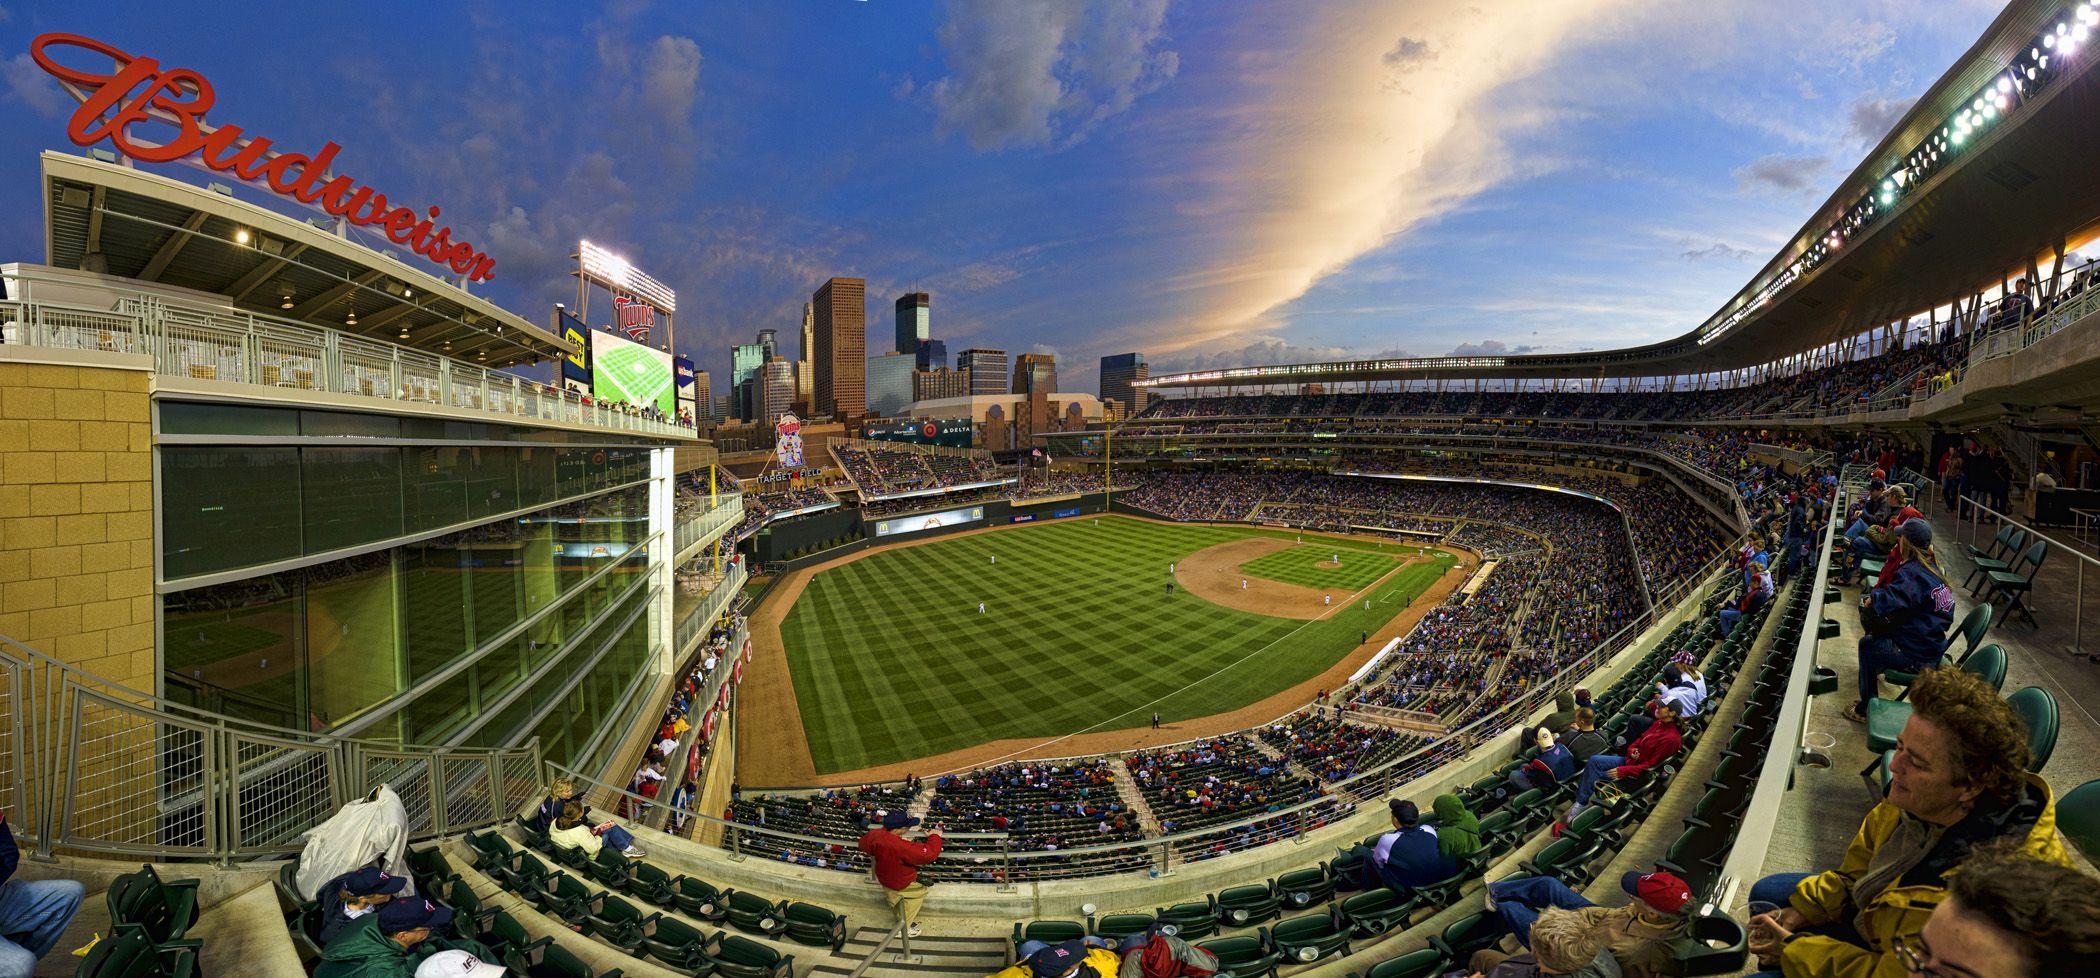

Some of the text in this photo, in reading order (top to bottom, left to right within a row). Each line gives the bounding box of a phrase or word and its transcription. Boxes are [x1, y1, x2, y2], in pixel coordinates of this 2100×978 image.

[30, 31, 495, 283] Budweiser
[614, 296, 654, 331] Twins
[757, 468, 822, 483] TARGET FIELD
